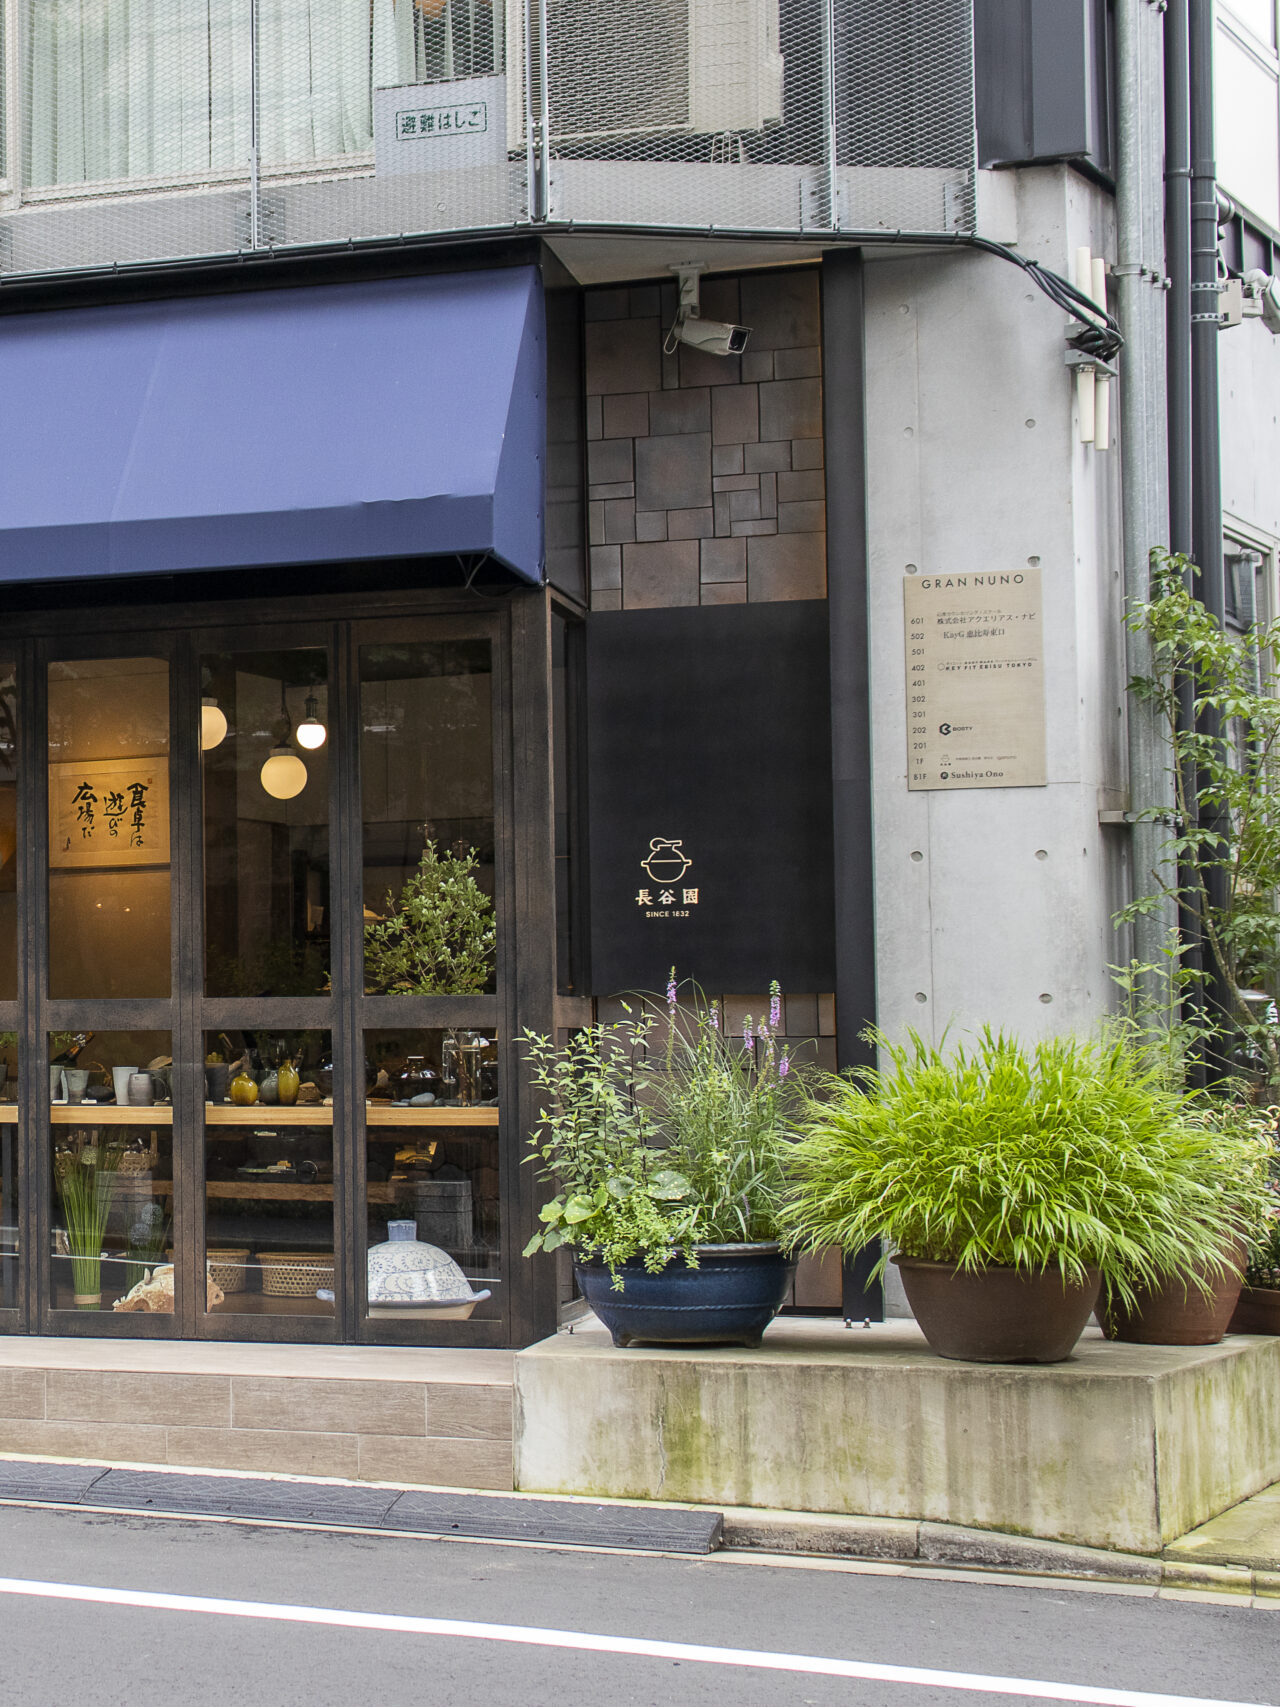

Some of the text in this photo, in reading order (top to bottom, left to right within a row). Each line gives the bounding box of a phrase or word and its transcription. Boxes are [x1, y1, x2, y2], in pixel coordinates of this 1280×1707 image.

[401, 108, 482, 134] 避難はしご
[921, 574, 1024, 589] GRAN NUNO
[912, 679, 926, 687] 401
[912, 695, 926, 703] 302
[912, 726, 927, 734] 202
[913, 742, 927, 750] 201
[951, 770, 1004, 780] Sushiya Ono
[634, 888, 699, 906] 長谷園
